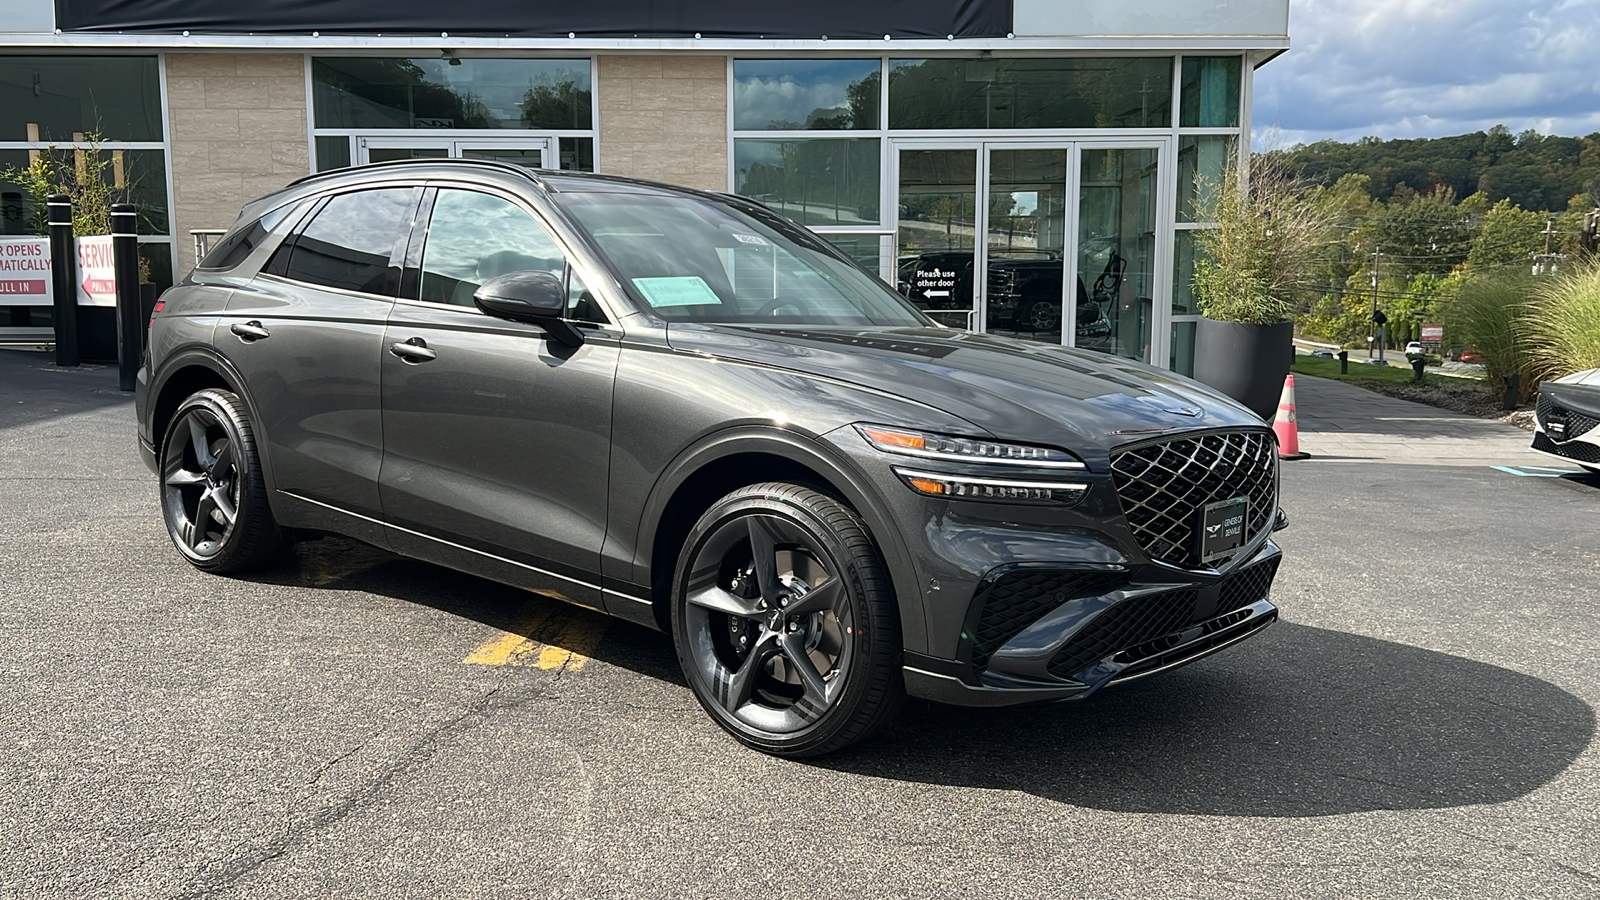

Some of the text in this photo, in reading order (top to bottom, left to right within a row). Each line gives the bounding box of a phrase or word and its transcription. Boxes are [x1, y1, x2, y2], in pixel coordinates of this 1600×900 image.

[6, 244, 42, 256] OPENS
[78, 243, 114, 268] SERVIC
[0, 259, 52, 271] ATICALLY
[917, 270, 941, 278] Please
[0, 282, 30, 292] ULL IN
[91, 281, 106, 292] PULL
[917, 279, 954, 287] other door
